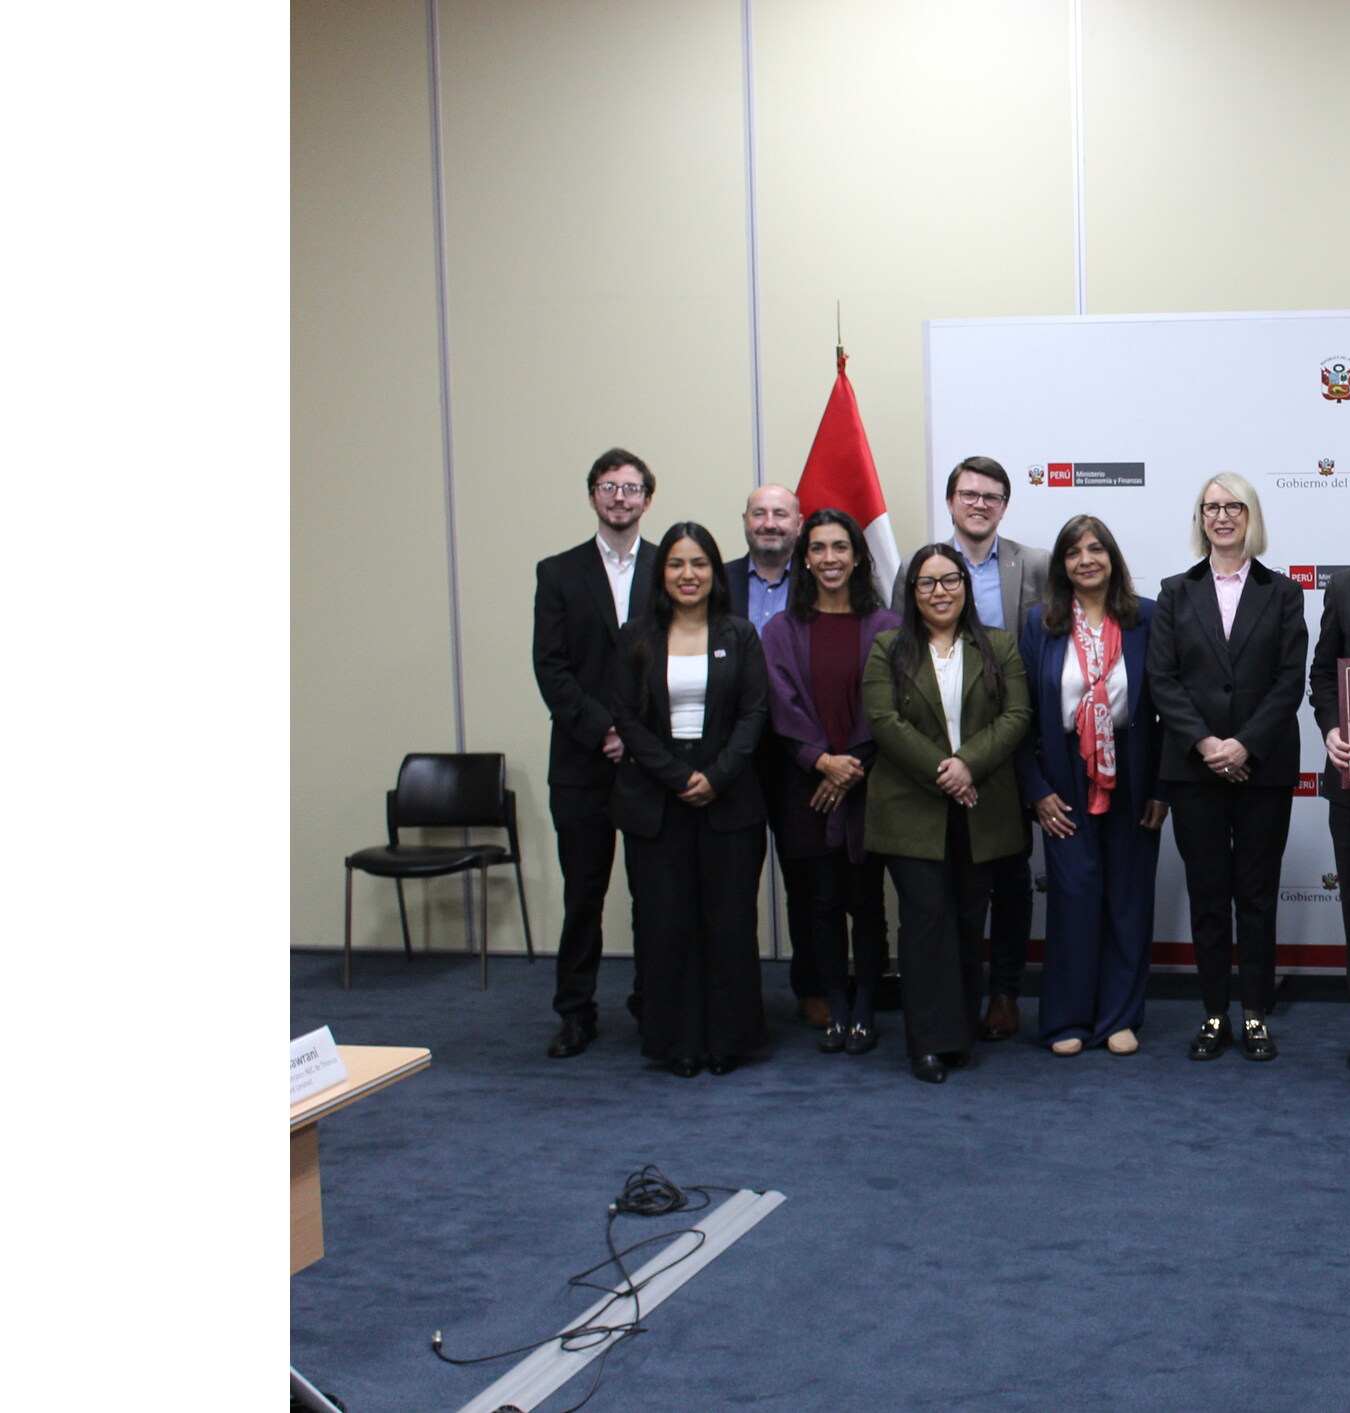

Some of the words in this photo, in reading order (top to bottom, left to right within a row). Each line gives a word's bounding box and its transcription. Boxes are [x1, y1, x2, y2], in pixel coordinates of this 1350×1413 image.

[1049, 469, 1071, 480] PERÚ
[1084, 477, 1113, 485] Economía
[1117, 477, 1143, 485] Finanzas
[1276, 478, 1328, 489] Gobierno
[1331, 477, 1348, 488] del
[1280, 891, 1332, 902] Gobierno
[290, 1046, 319, 1070] awrani
